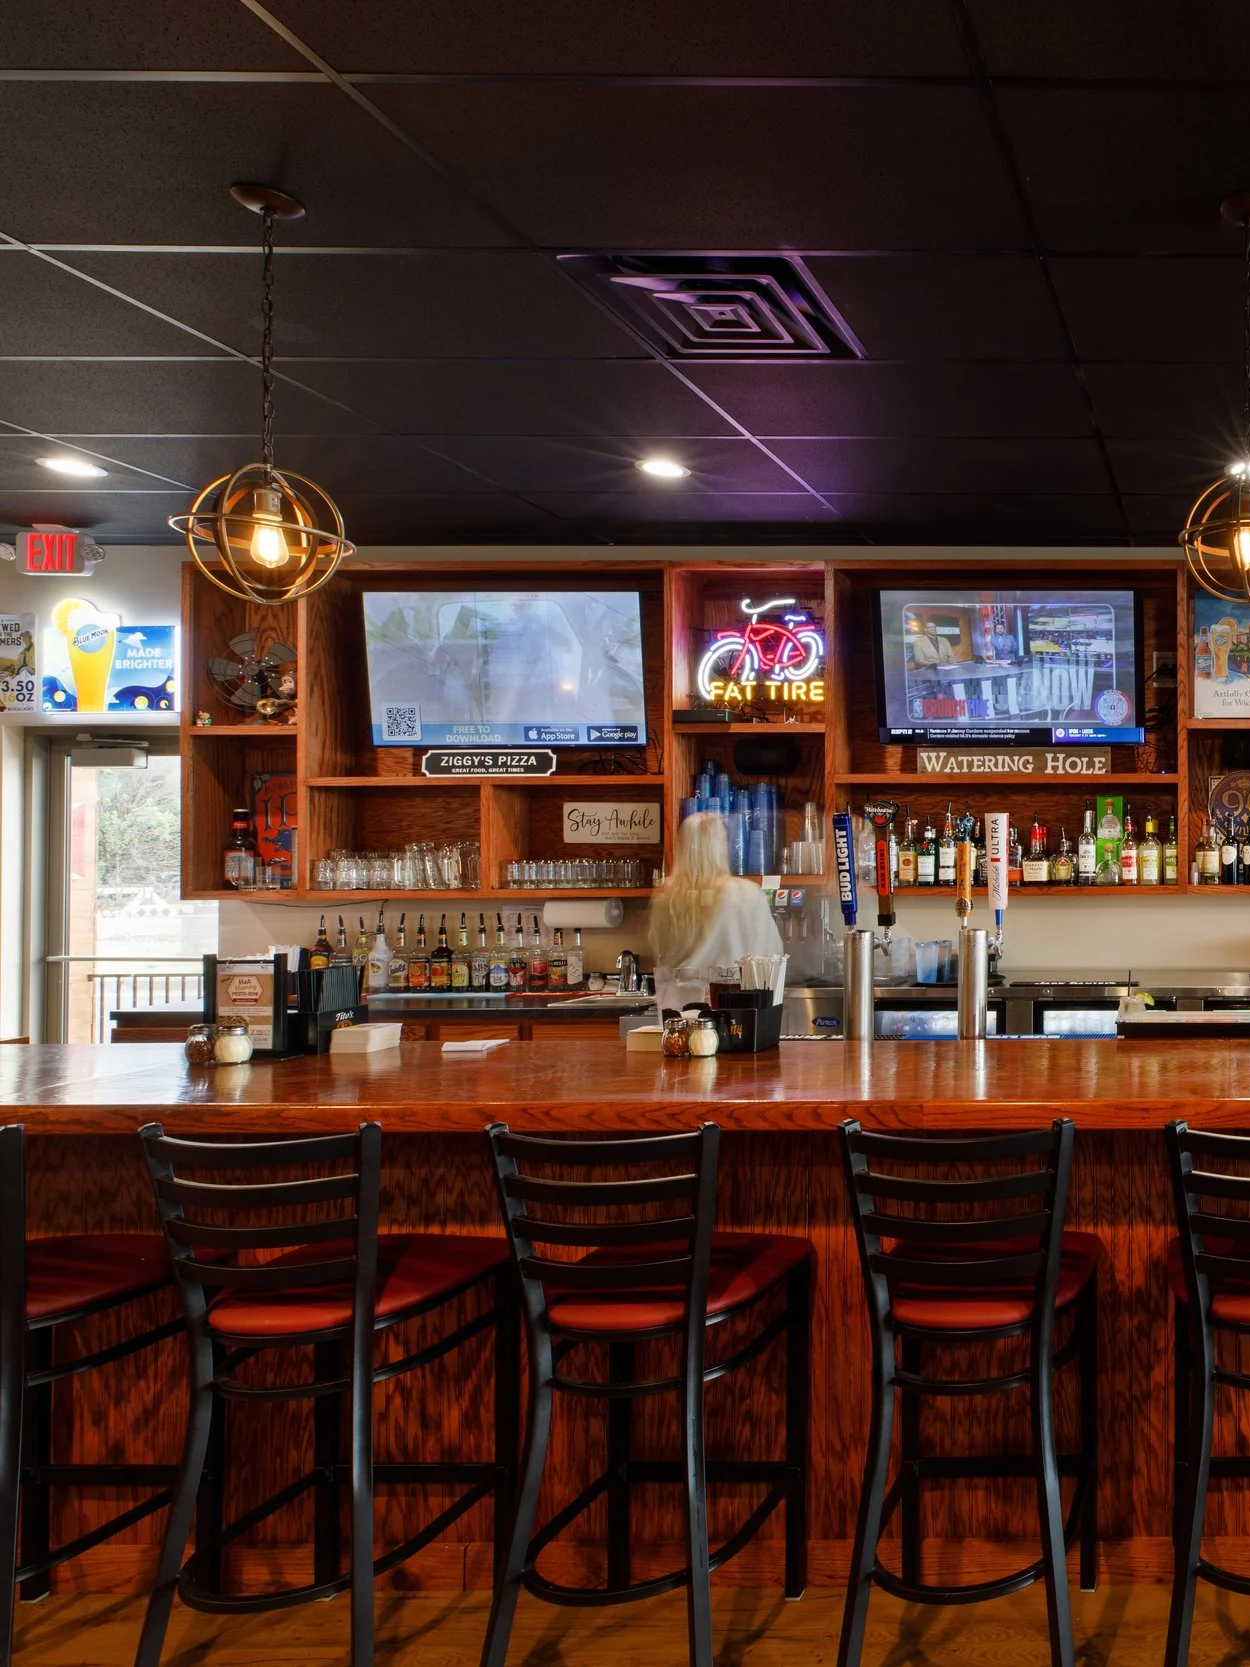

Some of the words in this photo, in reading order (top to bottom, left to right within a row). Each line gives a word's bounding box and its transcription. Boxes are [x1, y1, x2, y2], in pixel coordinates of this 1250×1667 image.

[27, 533, 77, 571] EXIT
[72, 634, 90, 647] BLUE
[91, 628, 109, 639] MOON
[126, 648, 161, 658] MADE
[115, 660, 174, 669] BRIGHTER
[709, 681, 756, 701] FAT
[765, 681, 825, 701] TIRE
[1213, 690, 1243, 698] Artfully
[446, 734, 501, 743] DOWNLOAD
[541, 733, 555, 741] App
[602, 731, 624, 739] Google
[625, 731, 636, 739] play
[440, 756, 493, 766] ZIGGY'S
[499, 756, 537, 766] PIZZA
[919, 752, 1034, 774] WATERING
[1045, 752, 1107, 774] HOLE
[567, 808, 603, 836] Stay
[604, 808, 656, 830] Awhile
[990, 818, 1000, 855] ULTRA
[835, 829, 850, 870] LIGHT
[840, 871, 852, 902] BUD
[335, 1011, 354, 1021] Tito's
